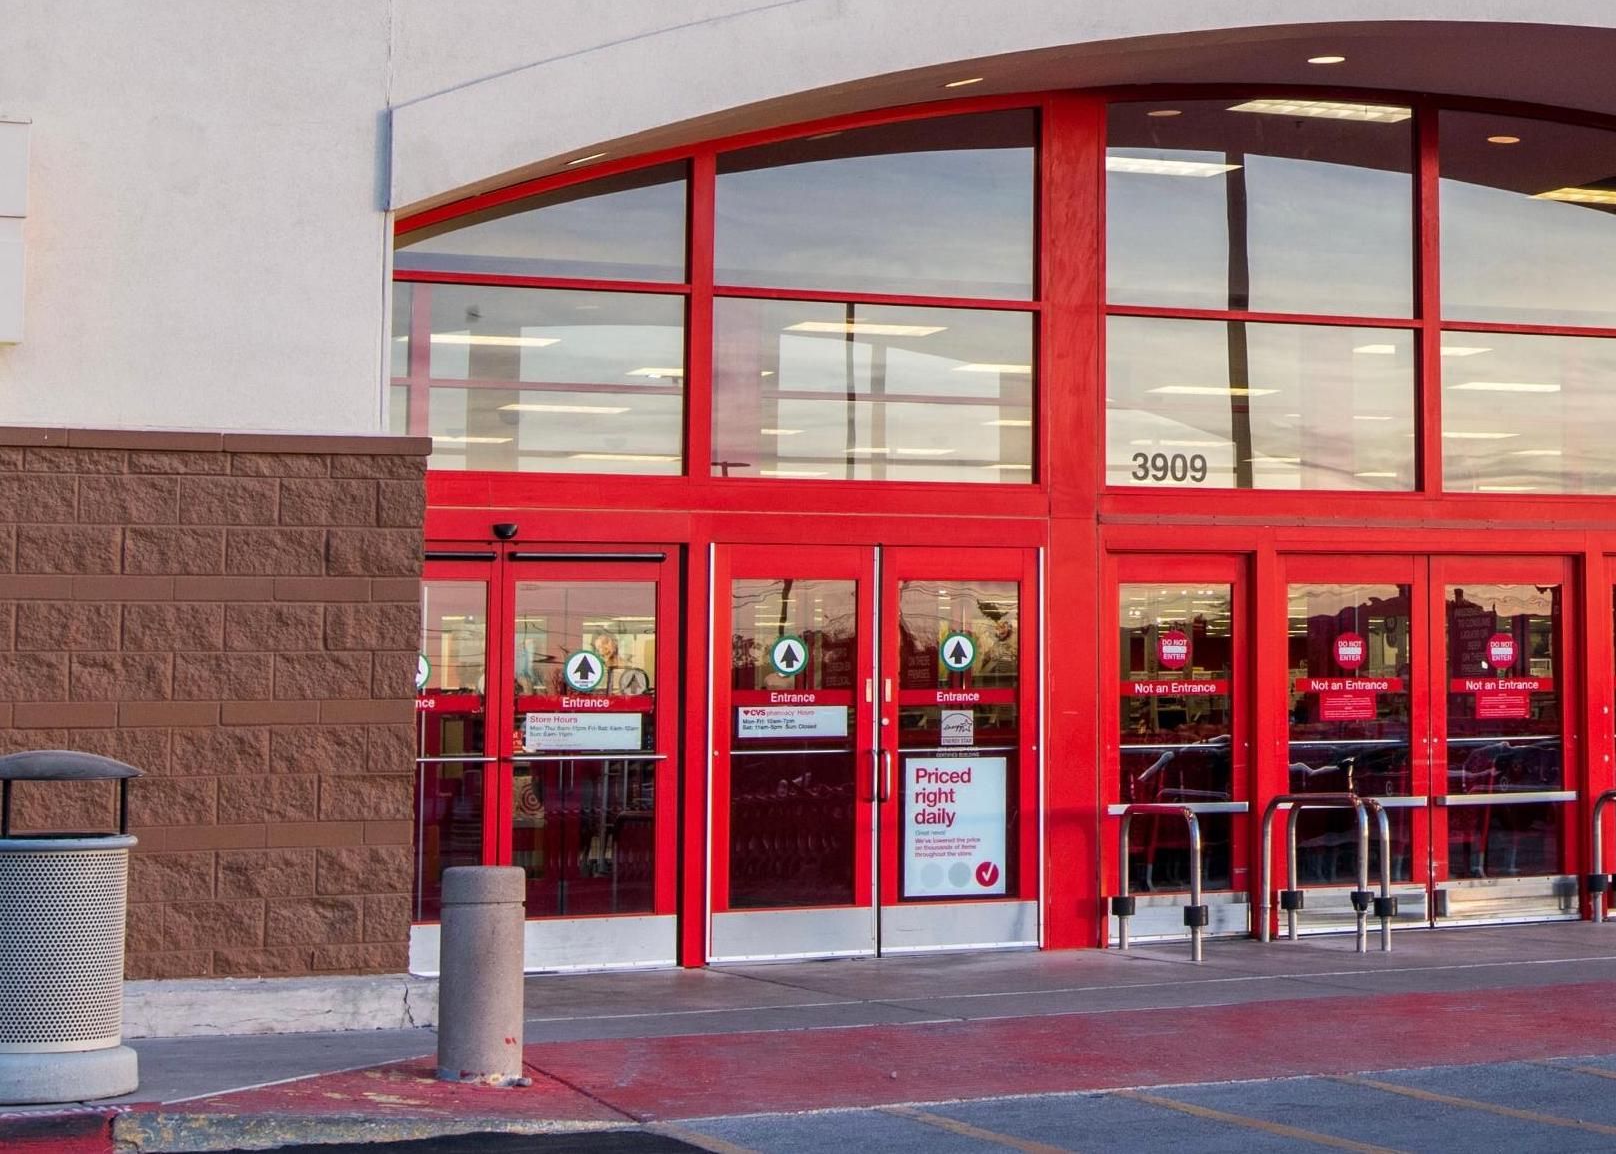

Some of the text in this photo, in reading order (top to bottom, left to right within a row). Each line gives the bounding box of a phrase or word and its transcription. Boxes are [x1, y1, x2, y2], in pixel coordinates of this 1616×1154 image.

[1131, 452, 1207, 482] 3909
[1134, 682, 1217, 694] Not an Entrance
[1311, 680, 1388, 690] Not an Entrance
[1465, 680, 1539, 690] Not an Entrance
[562, 696, 610, 708] Entrance
[770, 692, 816, 703] Entrance
[936, 691, 980, 702] Entrance
[529, 715, 578, 724] Store Hours
[915, 767, 972, 784] Priced
[915, 787, 956, 807] right
[914, 808, 956, 828] daily
